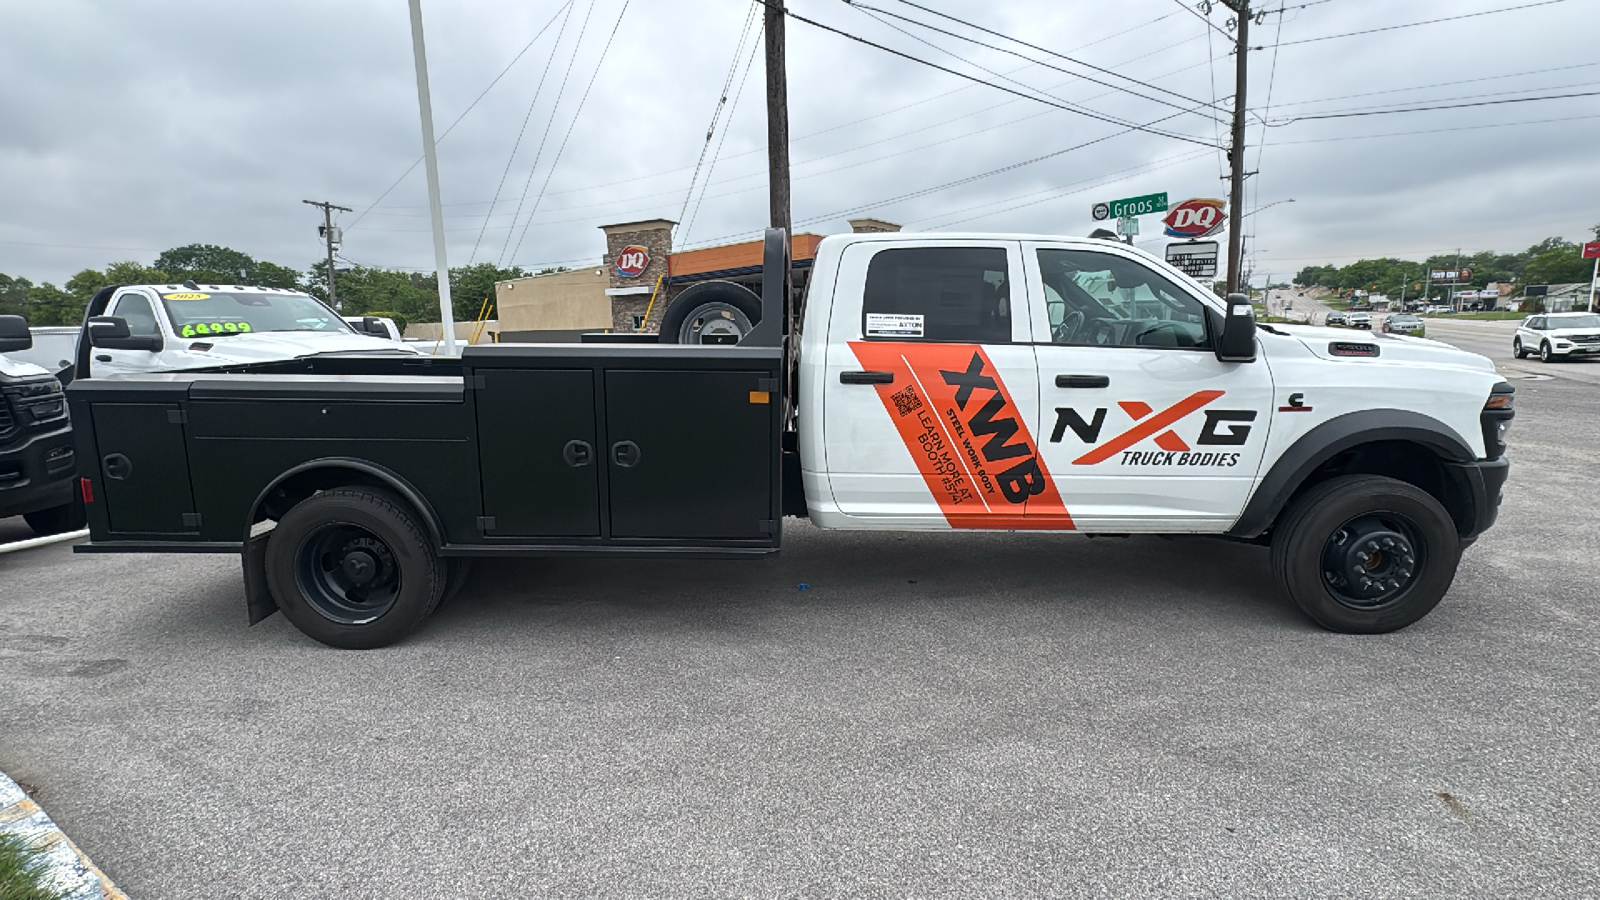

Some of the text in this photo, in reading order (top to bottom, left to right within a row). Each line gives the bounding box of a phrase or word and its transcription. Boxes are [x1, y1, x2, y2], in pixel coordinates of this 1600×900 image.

[1114, 200, 1152, 216] Groos
[1173, 206, 1216, 228] DQ
[621, 252, 644, 269] DQ
[917, 409, 973, 500] LEARN MORE AT
[938, 350, 1046, 504] XWB
[946, 408, 996, 494] STEEL WORK BODY
[1050, 390, 1258, 465] NXG
[1120, 451, 1241, 467] TRUCK BODIES
[917, 434, 963, 505] BOOTH #5741
